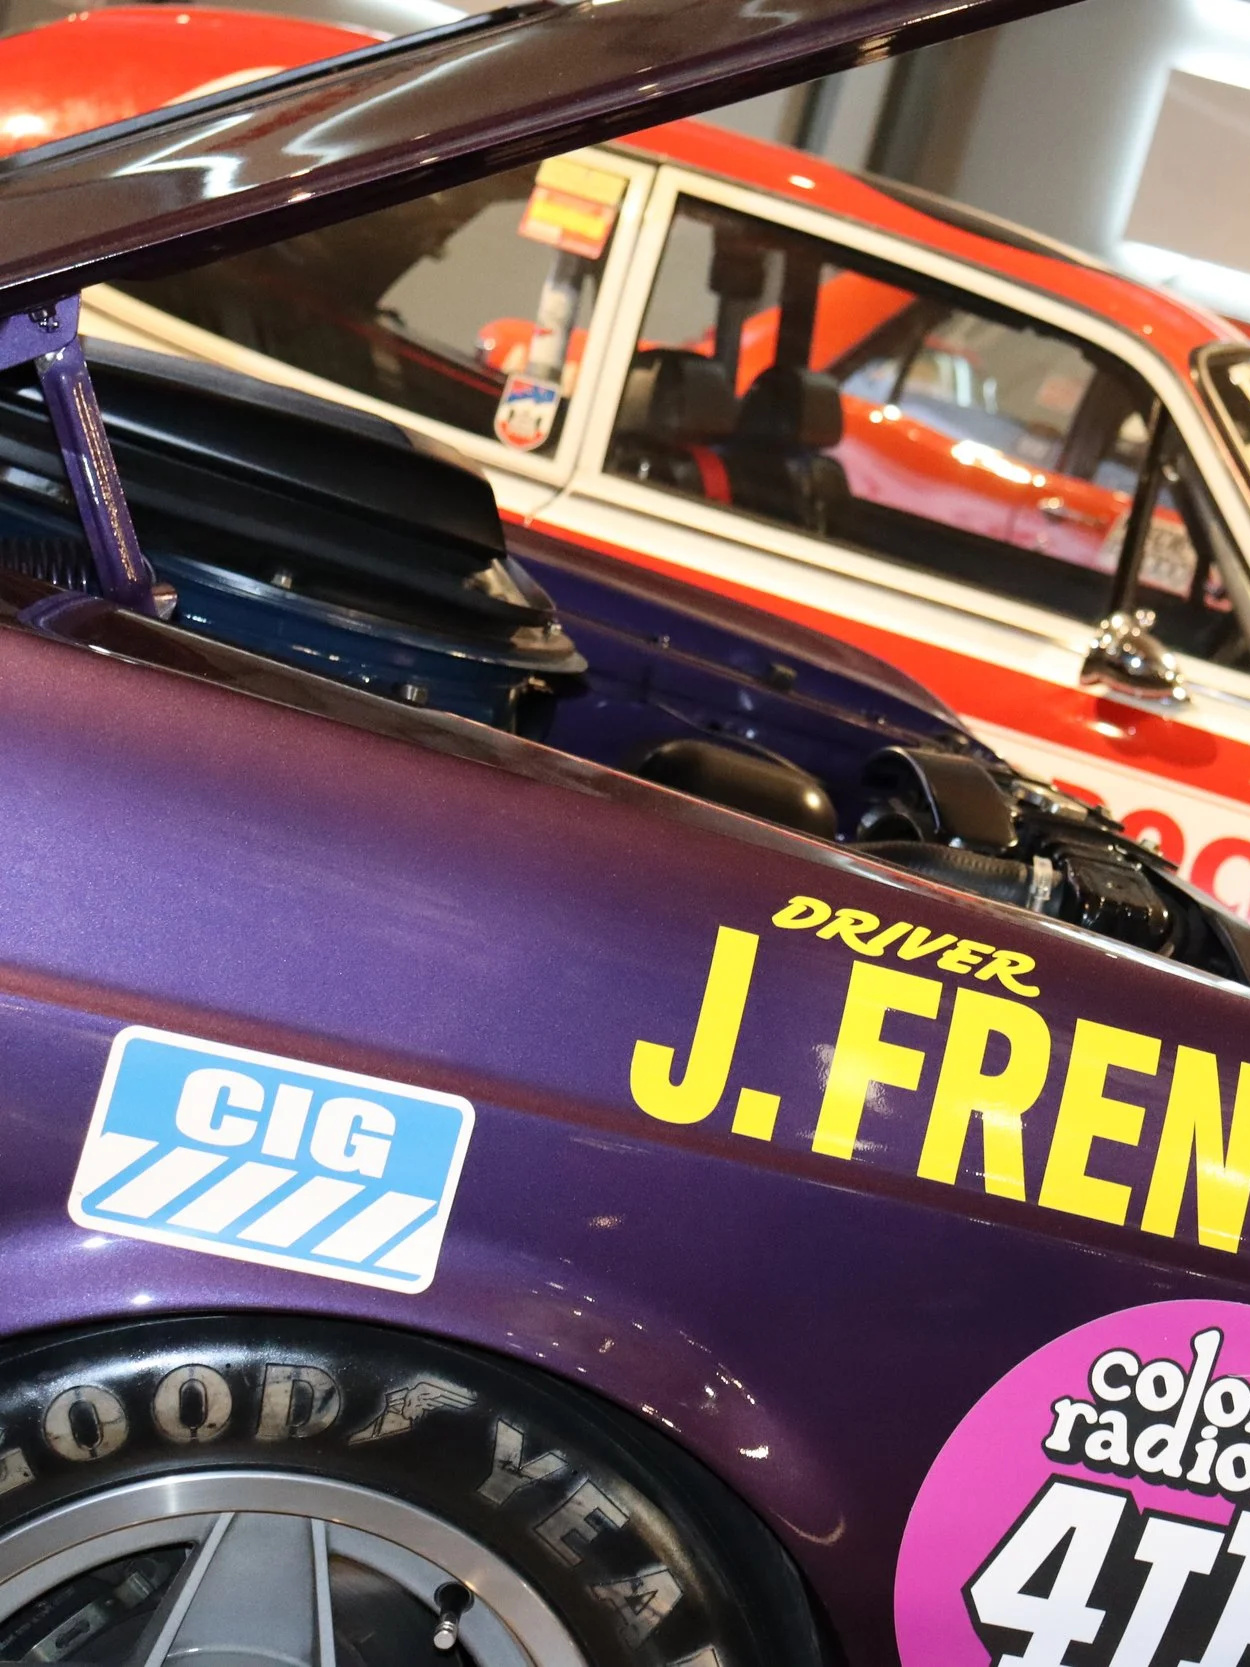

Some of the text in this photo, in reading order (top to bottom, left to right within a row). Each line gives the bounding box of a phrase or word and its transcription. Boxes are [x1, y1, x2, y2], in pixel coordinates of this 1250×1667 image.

[772, 895, 1041, 998] DRIVER
[630, 926, 780, 1141] J.
[174, 1067, 397, 1179] CIG
